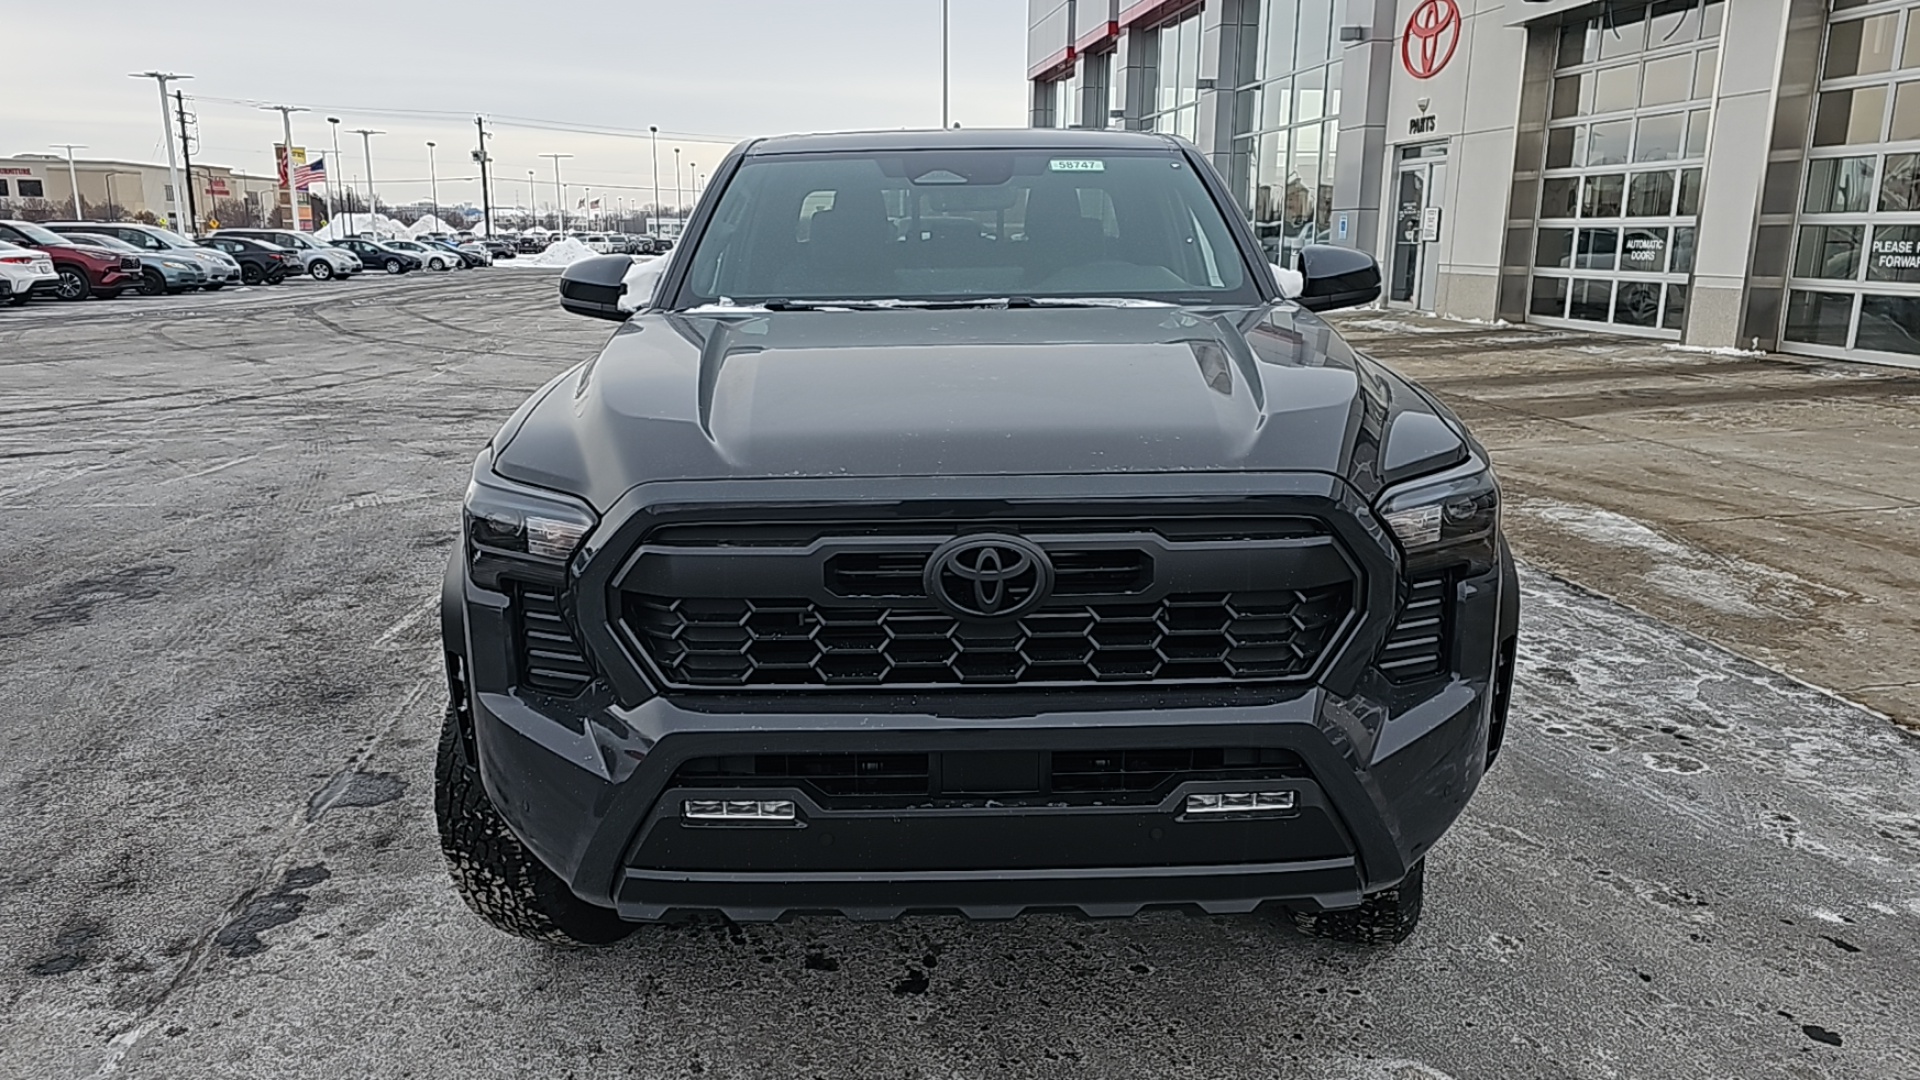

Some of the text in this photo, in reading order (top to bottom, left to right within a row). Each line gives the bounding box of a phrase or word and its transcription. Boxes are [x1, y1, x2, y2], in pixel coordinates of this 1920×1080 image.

[1409, 115, 1436, 135] PARTS
[1059, 161, 1095, 169] 58747
[1626, 239, 1665, 250] AUTOMATIC
[1872, 241, 1914, 254] PLEASE
[1631, 251, 1656, 261] DOORS
